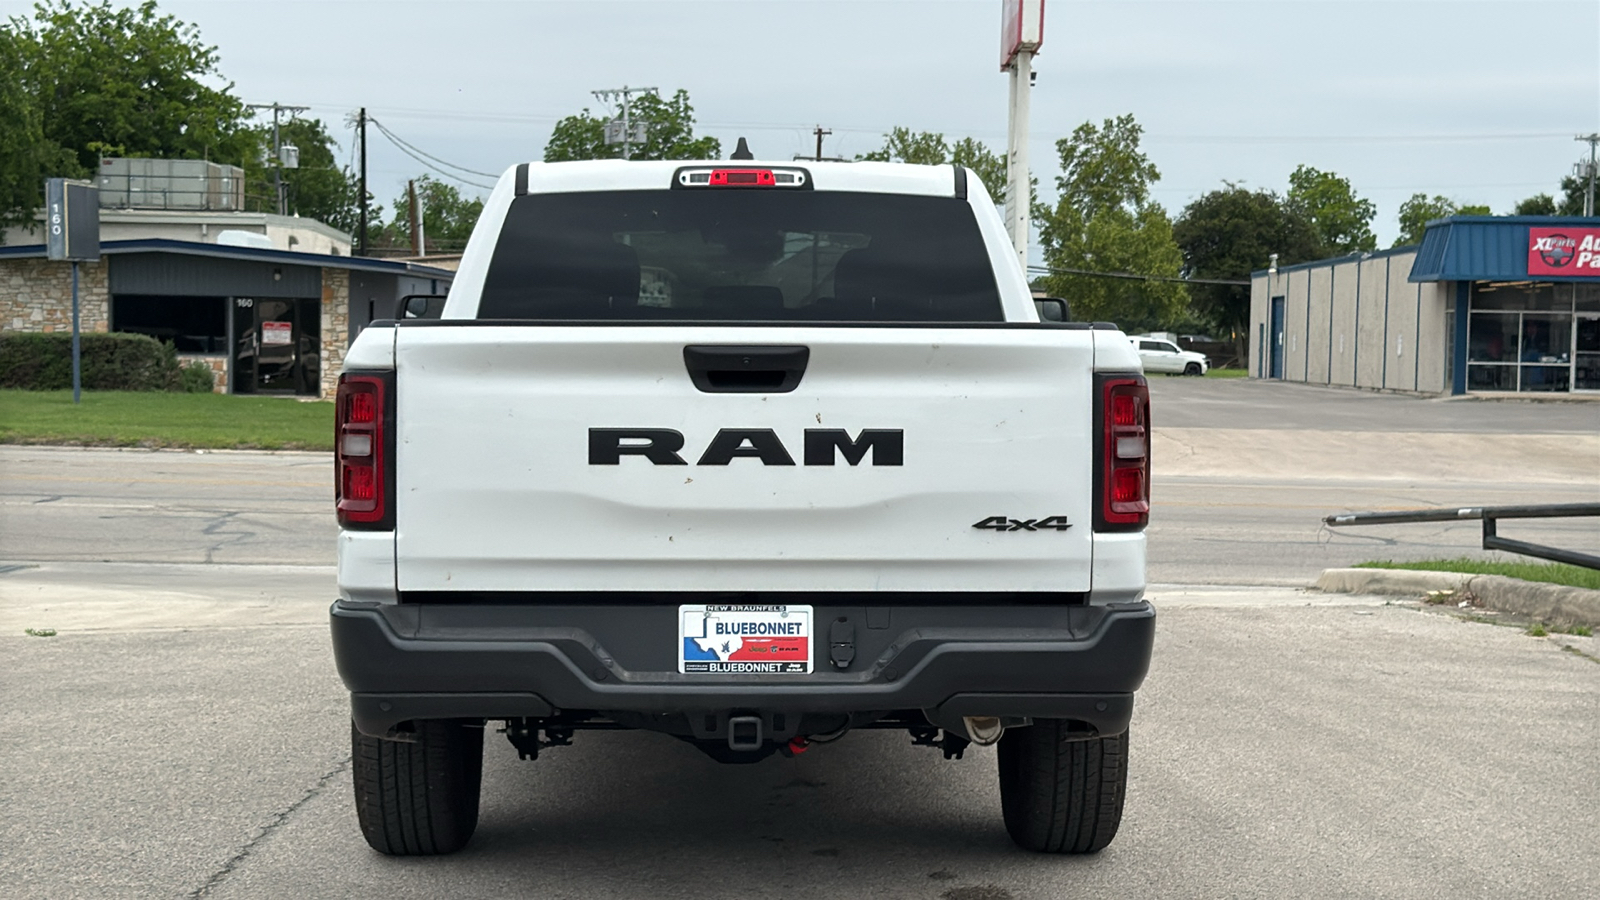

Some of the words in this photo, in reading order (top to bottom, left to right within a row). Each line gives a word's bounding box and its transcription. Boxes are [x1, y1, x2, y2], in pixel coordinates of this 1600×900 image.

[52, 203, 62, 236] 160
[237, 298, 253, 307] 160
[588, 428, 904, 466] RAM
[971, 515, 1073, 532] 4x4
[716, 622, 802, 635] BLUEBONNET
[709, 662, 783, 672] BLUEBONNET
